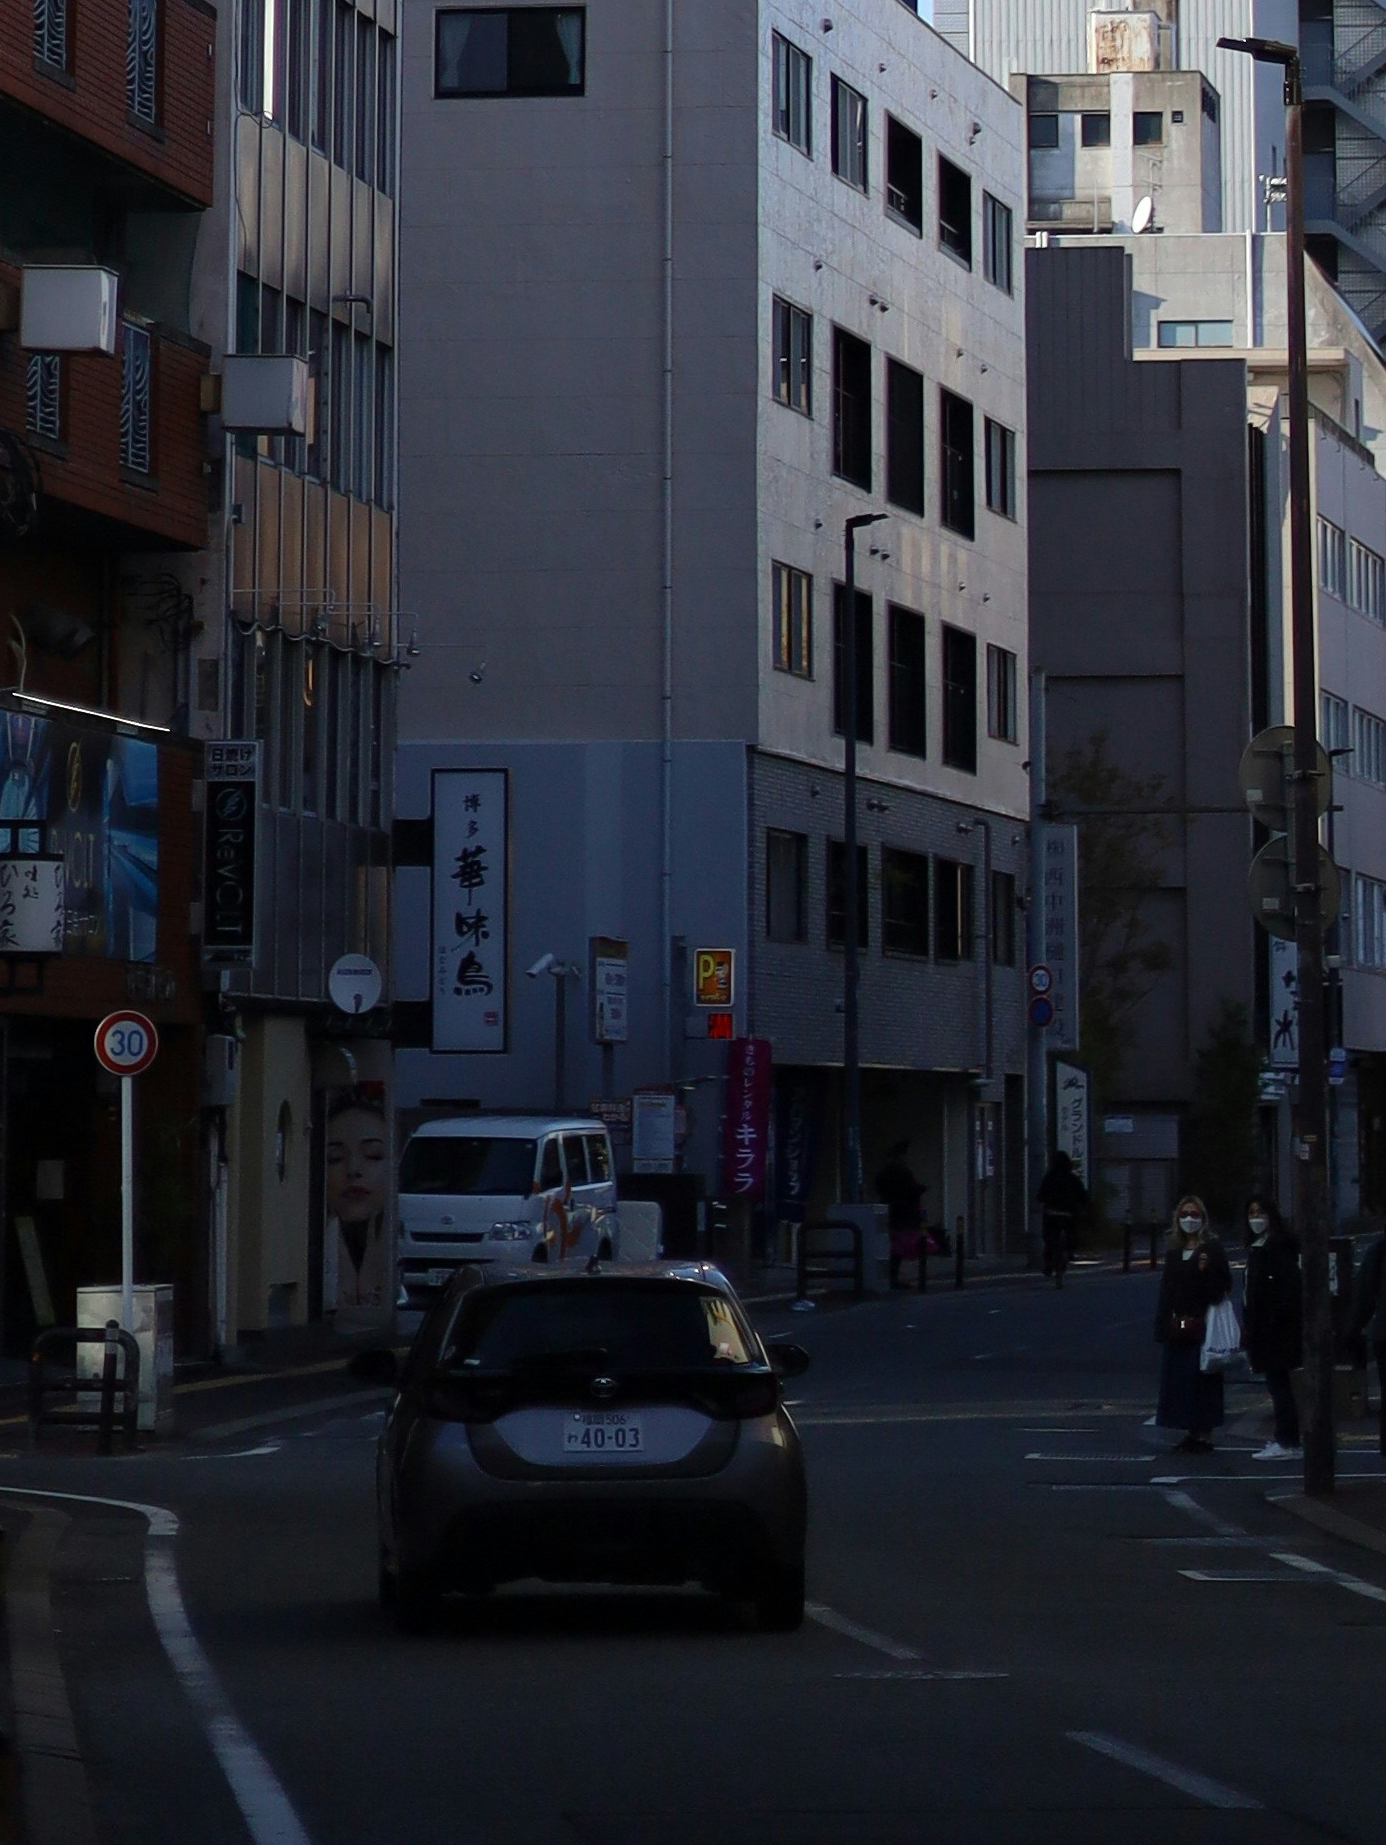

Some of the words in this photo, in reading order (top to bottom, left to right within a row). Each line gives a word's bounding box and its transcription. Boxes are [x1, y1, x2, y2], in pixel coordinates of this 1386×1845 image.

[698, 953, 714, 990] P
[110, 1030, 144, 1056] 30
[733, 1125, 758, 1194] キララ
[581, 1428, 639, 1449] 40-03
